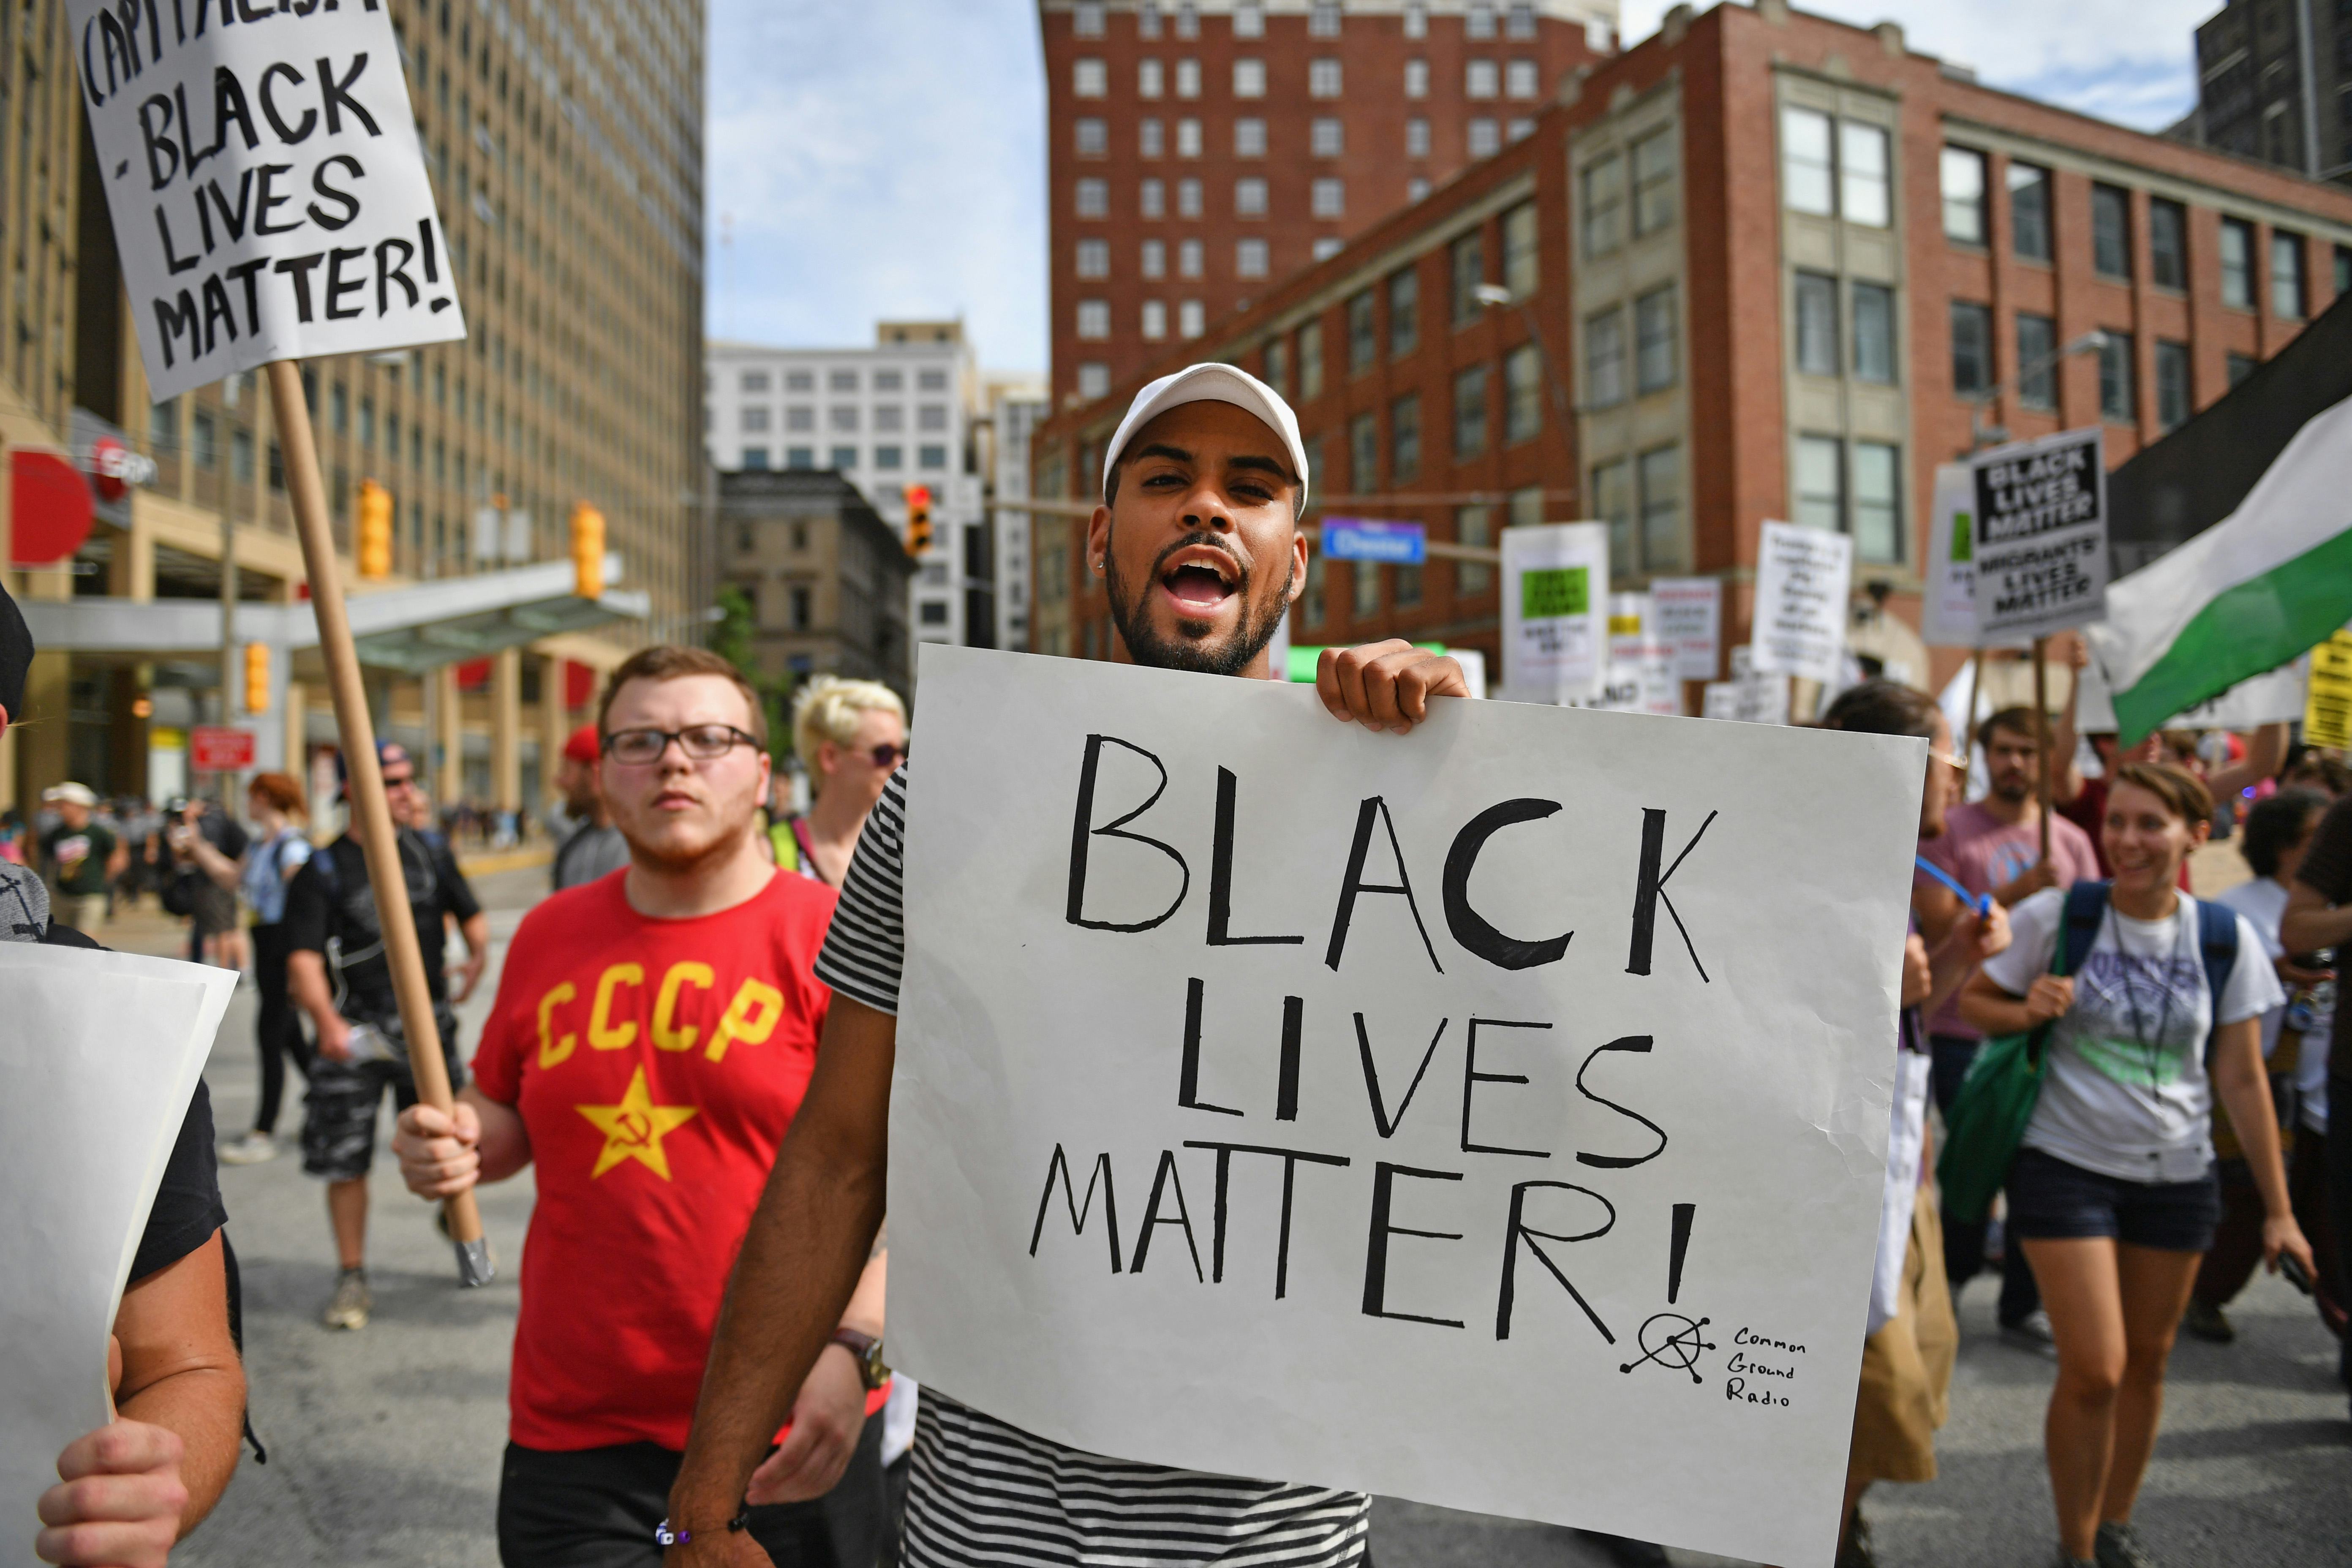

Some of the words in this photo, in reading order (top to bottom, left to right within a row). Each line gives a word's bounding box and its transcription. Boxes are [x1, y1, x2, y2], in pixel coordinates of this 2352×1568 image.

[137, 52, 382, 191] BLACK
[154, 155, 365, 276] LIVES
[152, 218, 451, 370] MATTER!
[1987, 448, 2085, 490] BLACK
[1987, 491, 2094, 539] MATTER
[1994, 473, 2080, 512] LIVES
[1994, 576, 2091, 613] MATTER
[2004, 563, 2077, 590] LIVES
[1065, 734, 1719, 984] BLACK
[1177, 977, 1668, 1169] LIVES
[1029, 1141, 1697, 1345] MATTER!
[1734, 1327, 1806, 1353] Common
[1727, 1352, 1794, 1379] Ground
[1726, 1377, 1789, 1407] Radio
